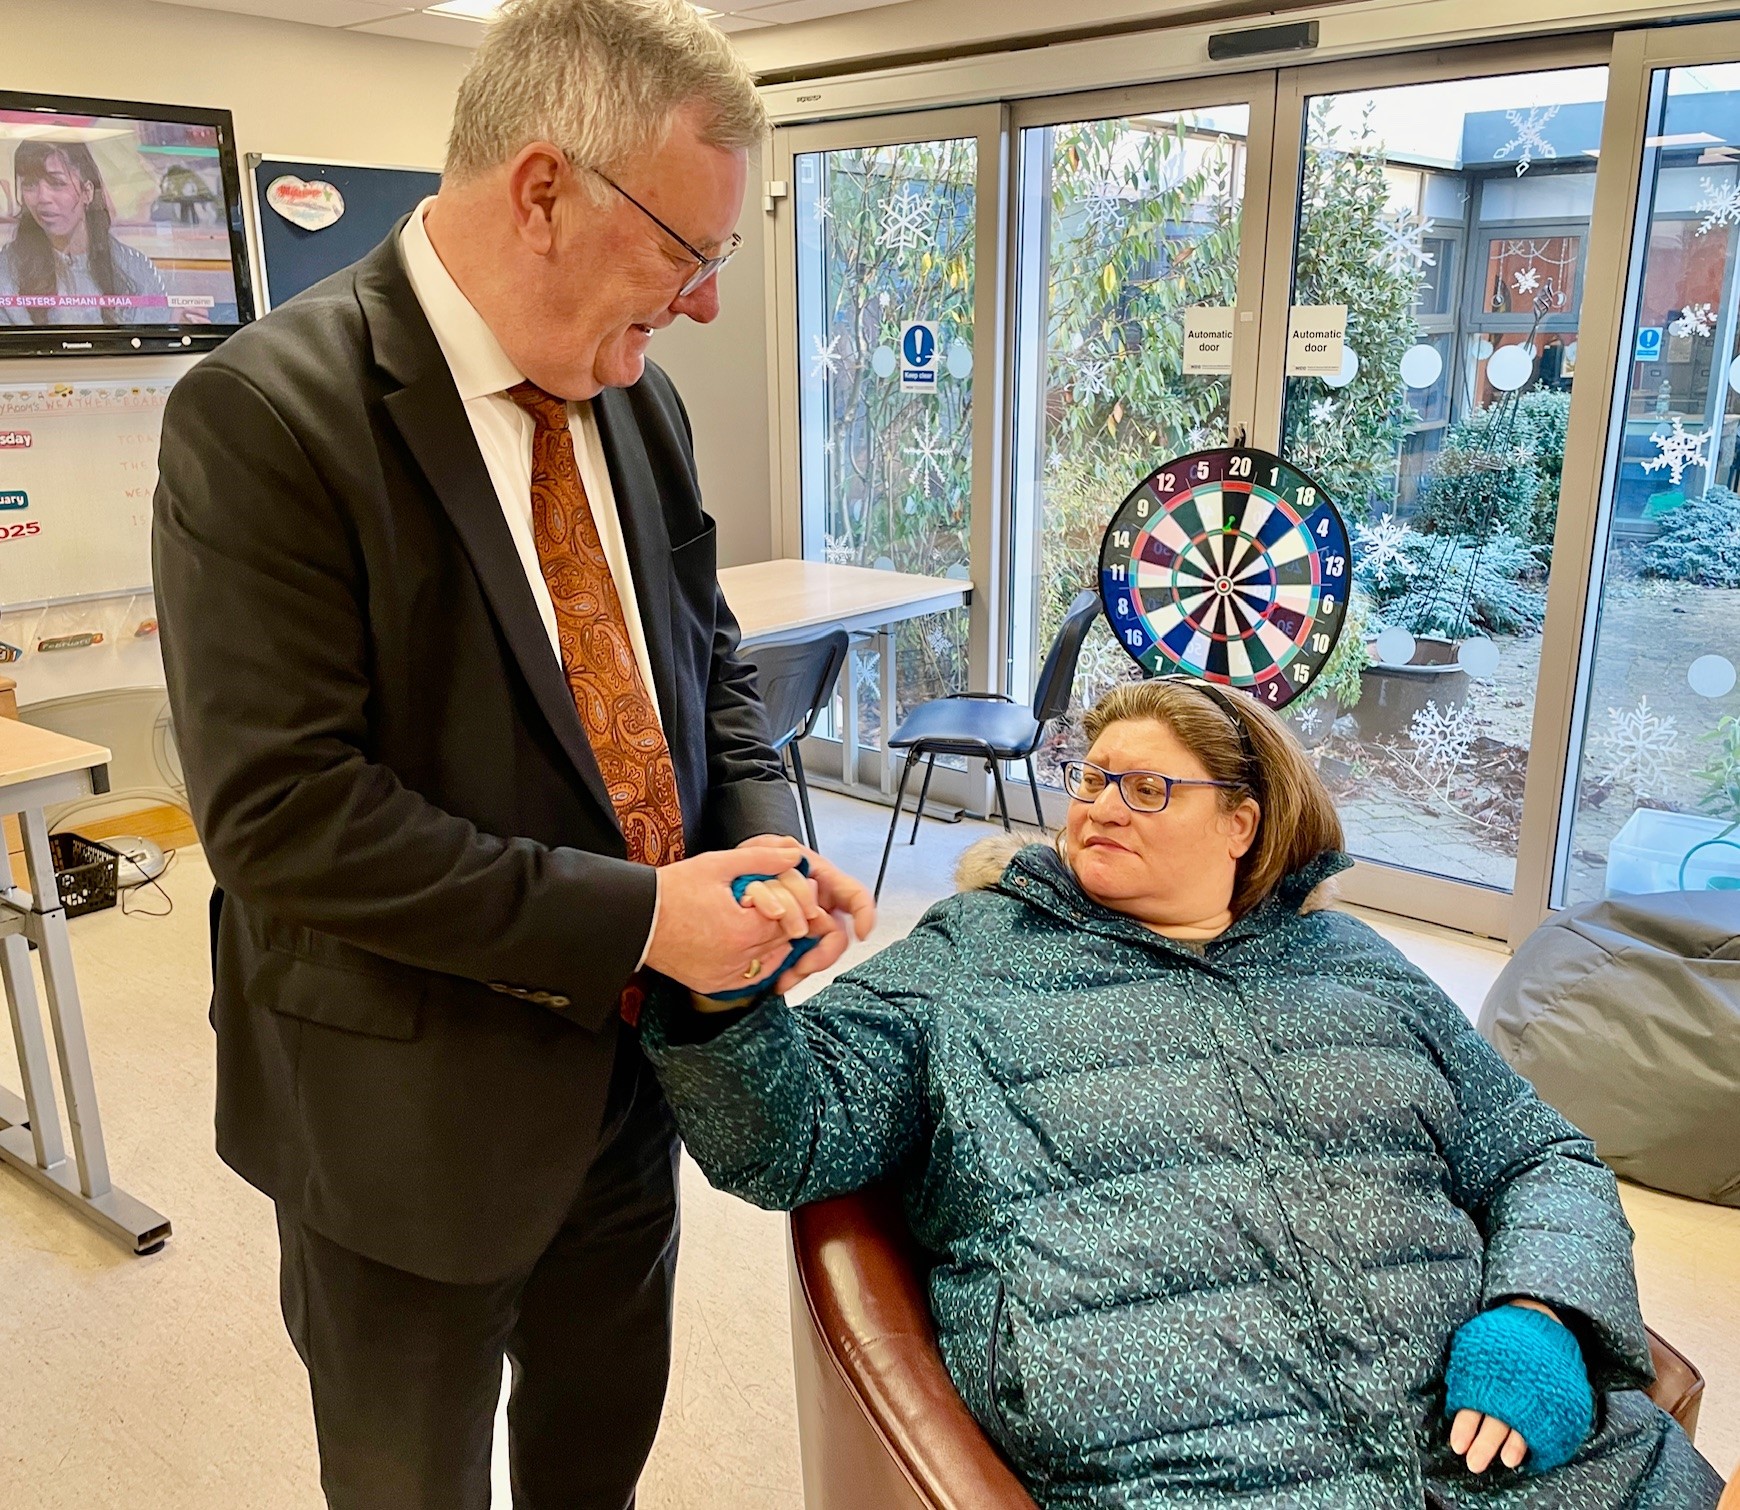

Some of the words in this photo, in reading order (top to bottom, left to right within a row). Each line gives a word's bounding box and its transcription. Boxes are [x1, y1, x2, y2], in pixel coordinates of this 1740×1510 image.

[16, 297, 56, 306] SISTERS
[59, 297, 97, 306] ARMANI
[99, 297, 105, 306] &
[108, 297, 132, 306] MAIA
[1188, 329, 1233, 339] Automatic
[1292, 329, 1342, 339] Automatic
[1199, 342, 1220, 352] door
[1304, 342, 1327, 353] door
[46, 397, 113, 411] WEATHER
[120, 460, 147, 471] THE
[1196, 461, 1210, 480] 5
[1229, 456, 1252, 477] 20
[1156, 472, 1176, 492] 12
[1269, 467, 1279, 487] 1
[1296, 486, 1316, 506] 18
[1136, 498, 1149, 518] 9
[1316, 518, 1330, 538] 4
[1112, 530, 1130, 549] 14
[1110, 563, 1125, 582] 11
[1325, 556, 1345, 577] 13
[1117, 597, 1129, 615] 8
[1321, 594, 1335, 615] 6
[1125, 628, 1143, 647] 16
[1312, 632, 1330, 654] 10
[1154, 655, 1163, 672] 7
[1293, 662, 1310, 684] 15
[1267, 682, 1279, 702] 2
